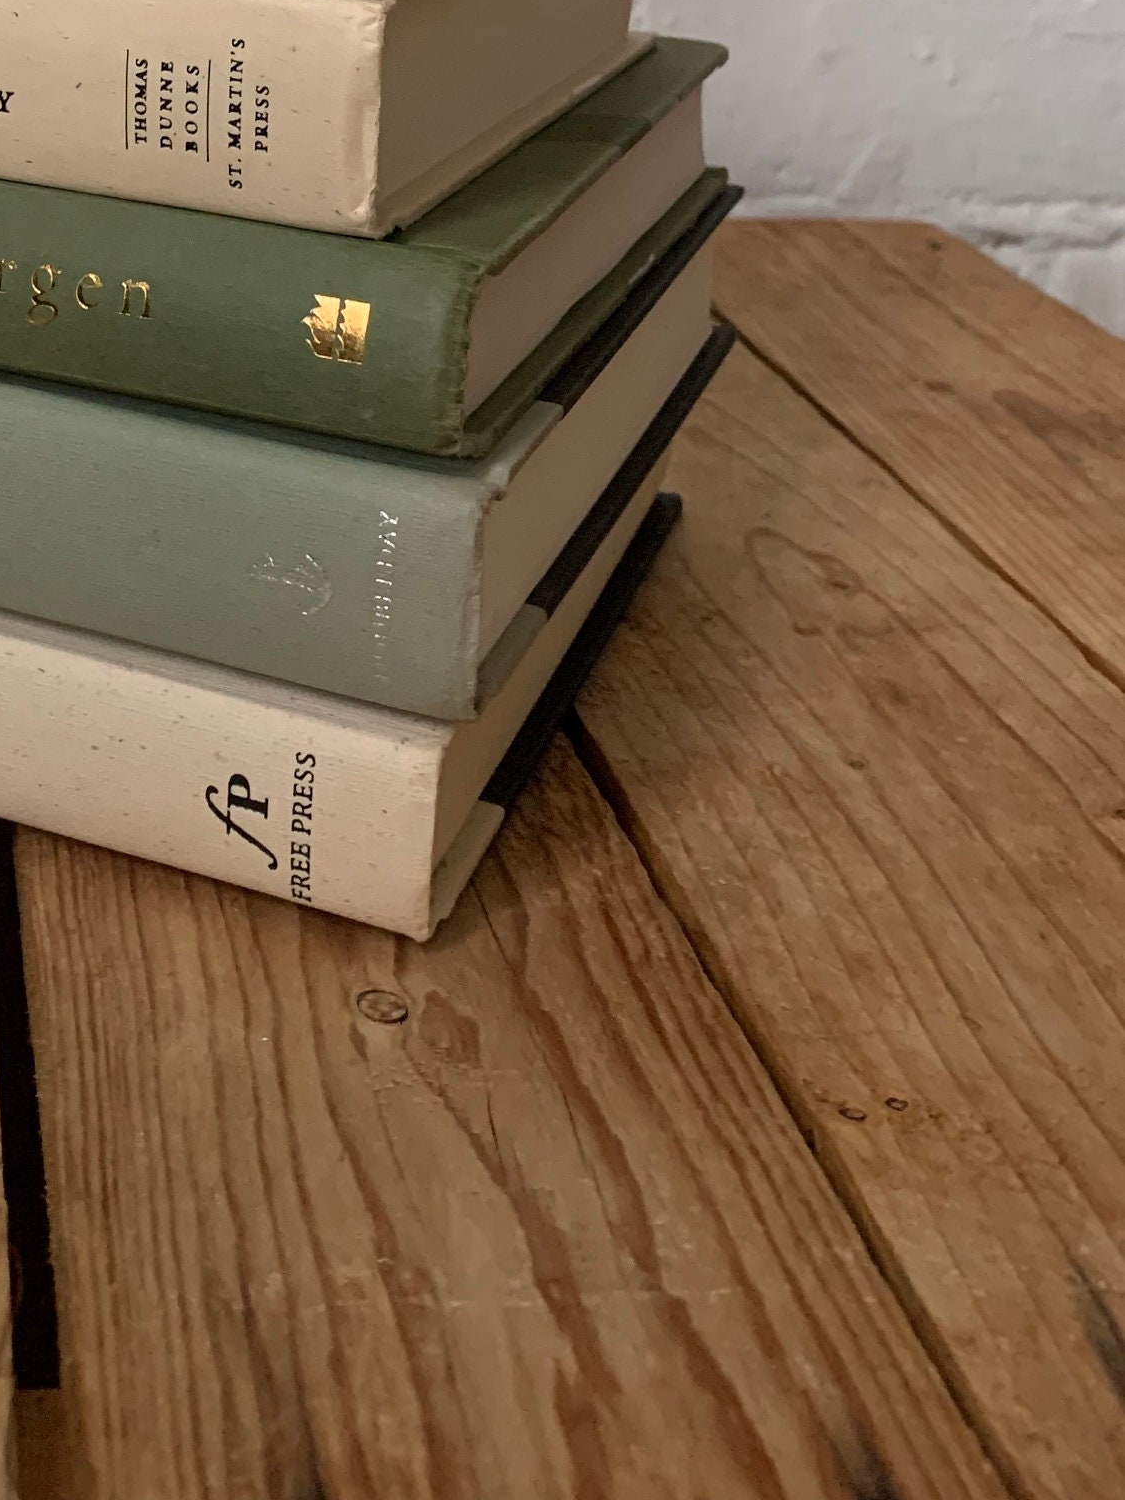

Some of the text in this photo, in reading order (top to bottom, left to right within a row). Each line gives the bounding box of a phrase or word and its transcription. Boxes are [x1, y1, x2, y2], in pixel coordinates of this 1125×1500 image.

[134, 57, 149, 145] THOMAS
[160, 60, 174, 150] DUNNE
[185, 65, 200, 153] BOOKS
[228, 37, 246, 190] ST. MARTIN'S
[255, 84, 270, 153] PRESS
[290, 751, 317, 903] FREE PRESS
